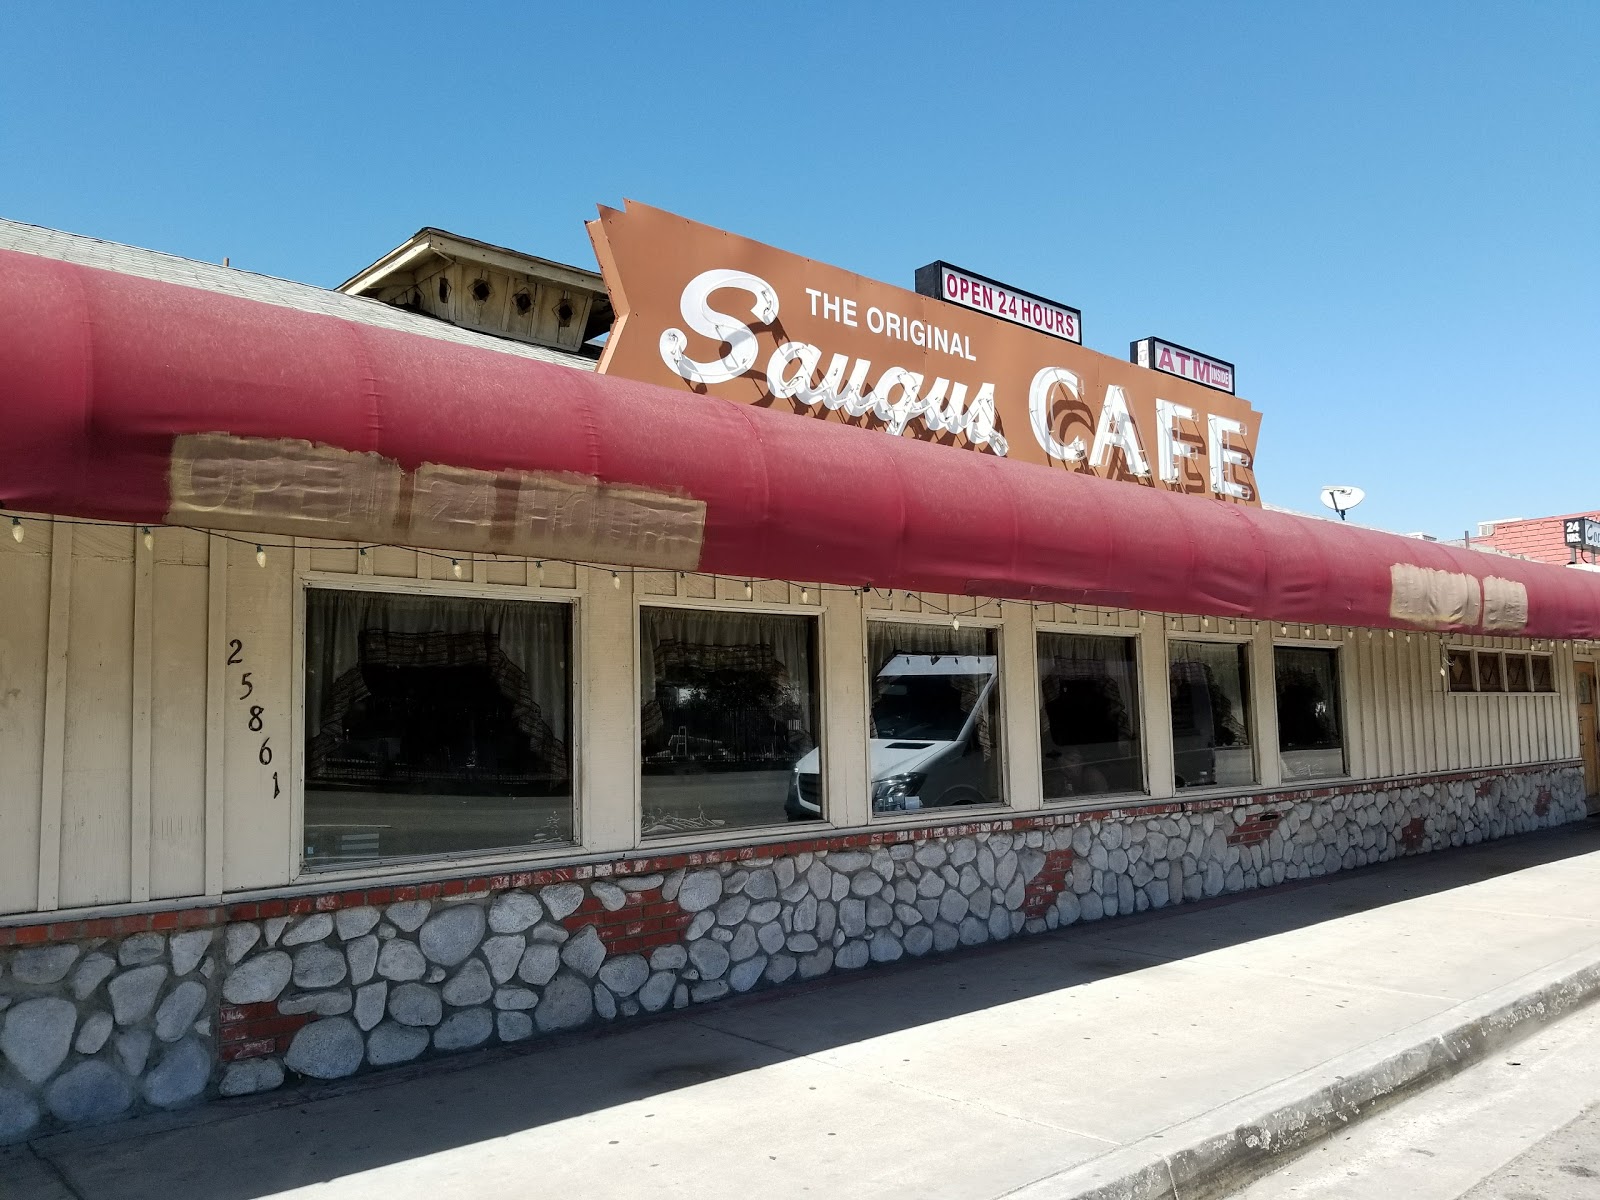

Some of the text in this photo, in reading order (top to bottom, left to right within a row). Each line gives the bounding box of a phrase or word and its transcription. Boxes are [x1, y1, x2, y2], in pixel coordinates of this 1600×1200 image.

[805, 288, 977, 361] THE ORIGINAL
[946, 273, 1074, 337] OPEN 24 HOURS
[659, 268, 1009, 457] Saugus
[1158, 347, 1210, 383] ATM
[1211, 367, 1229, 385] INSIDE
[1028, 366, 1251, 500] CAFE
[1566, 521, 1580, 532] 24
[227, 638, 281, 799] 25861
